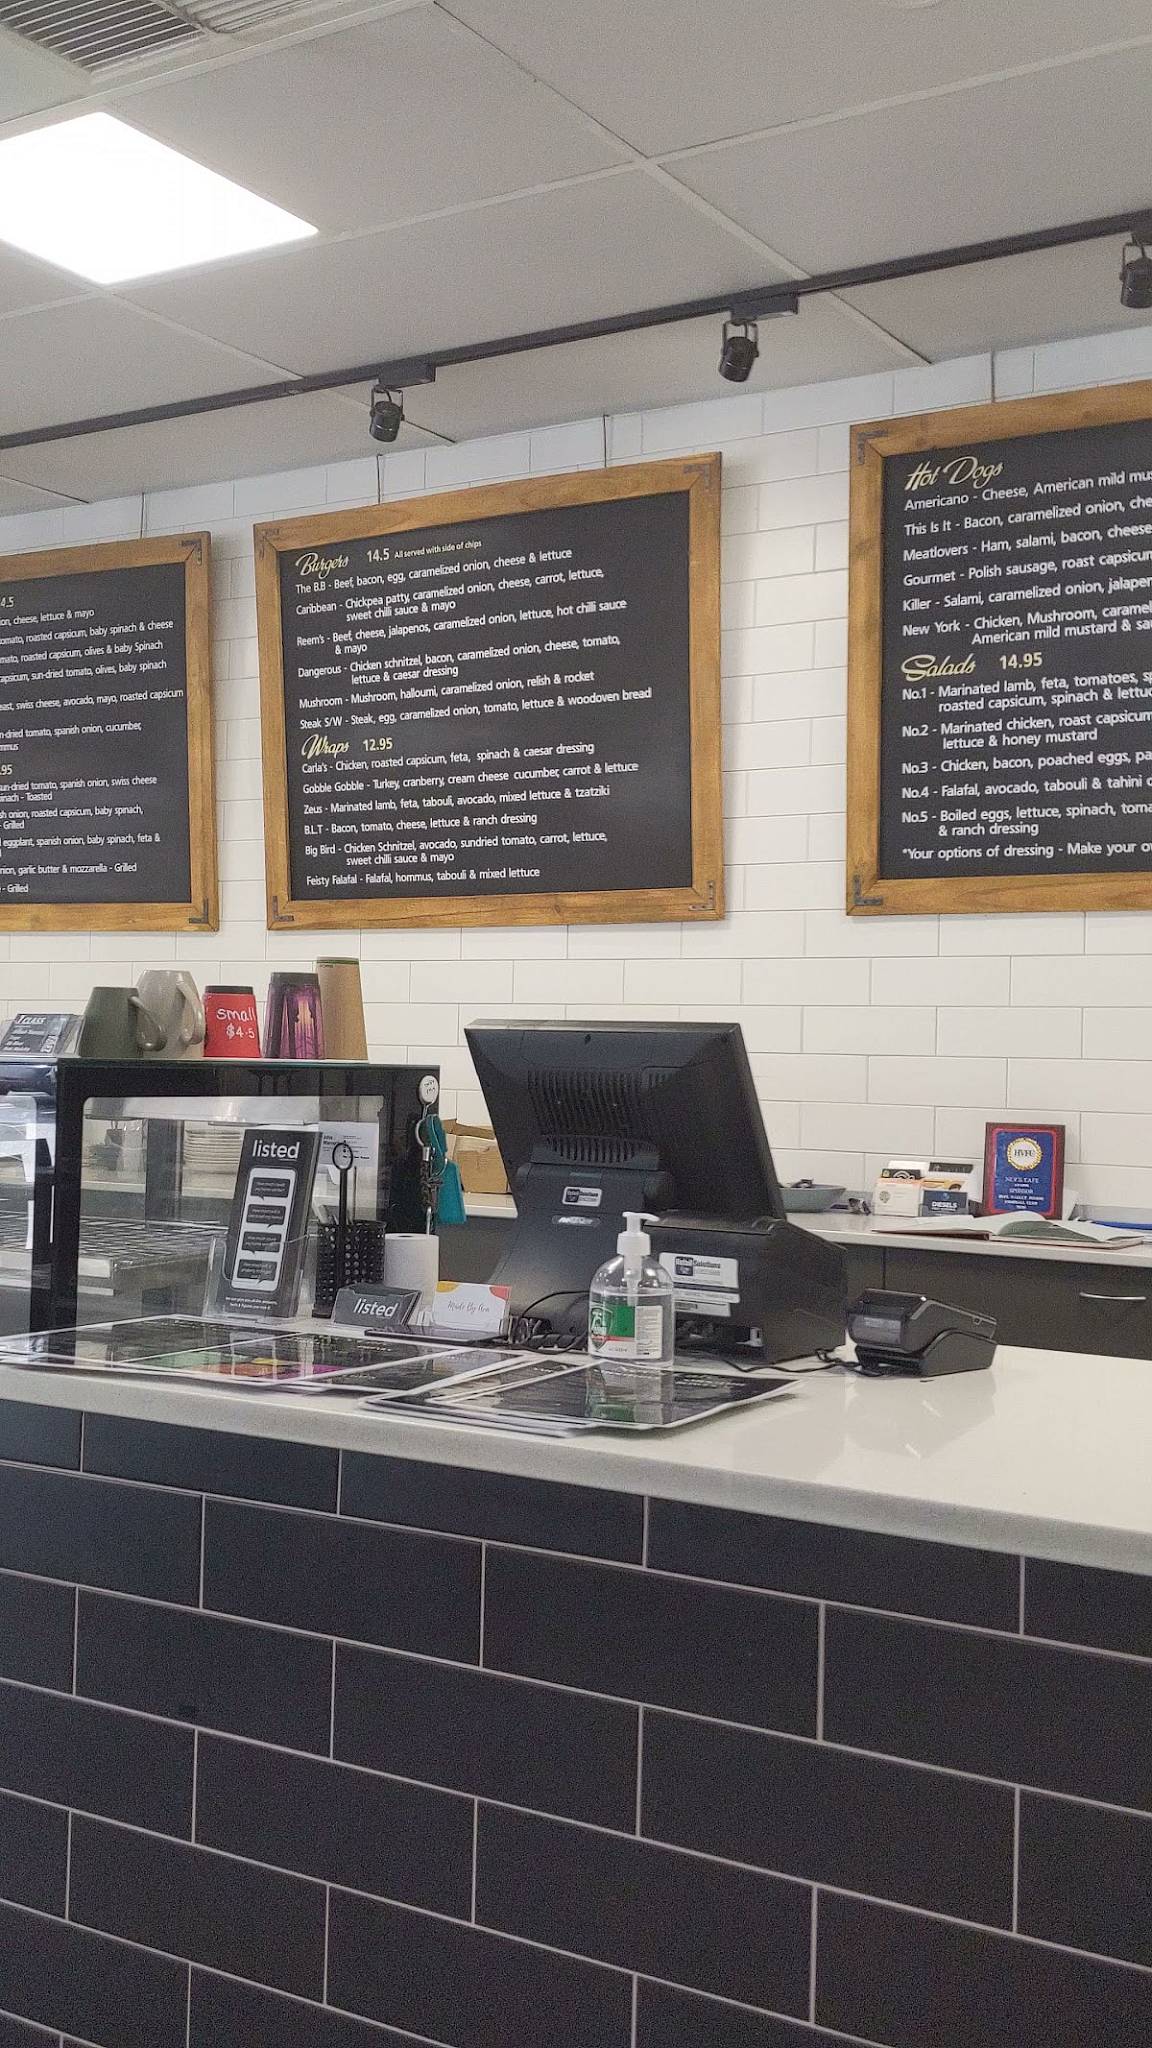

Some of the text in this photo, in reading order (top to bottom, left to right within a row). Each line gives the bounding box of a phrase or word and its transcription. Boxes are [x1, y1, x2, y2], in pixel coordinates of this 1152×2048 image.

[904, 456, 1003, 491] Hot Dogs
[904, 470, 1126, 511] Americano Cheese, American mild
[903, 499, 1126, 536] This Is It Bacon, caramelized onion,
[903, 529, 1103, 562] Meatlovers Ham, salami, bacon,
[295, 547, 390, 579] Burgers 14.5
[295, 583, 312, 594] The
[408, 562, 461, 579] caramelized
[493, 556, 526, 568] cheese
[539, 549, 573, 562] lettuce
[903, 554, 1095, 587] Gourmet Polish sausage, roast
[902, 580, 1105, 612] Killer Salami, caramelized onion,
[296, 634, 325, 647] Reem's
[433, 614, 486, 631] caramelized
[556, 605, 574, 616] hot
[575, 600, 597, 614] chilli
[598, 599, 628, 612] sauce
[902, 609, 1098, 637] New York Chicken, Mushroom,
[971, 619, 1117, 645] American mild mustard
[297, 665, 342, 679] Dangerous
[349, 660, 382, 672] Chicken
[457, 644, 510, 661] caramelized
[901, 651, 1043, 682] Salads 14.95
[902, 672, 1139, 701] No.1 Marinated lamb, feta, tomatoes,
[938, 688, 1099, 713] roasted capsicum, spinach
[299, 717, 322, 730] Steak
[324, 716, 343, 728] S/W
[399, 705, 451, 721] caramelized
[521, 698, 555, 710] lettuce
[567, 692, 620, 706] woodoven
[622, 686, 652, 701] bread
[902, 714, 1092, 737] No.2 Marinated chicken, roast
[942, 727, 1098, 750] lettuce honey mustard
[301, 733, 393, 760] Wraps 12.95
[901, 751, 1132, 775] No.3 Chicken, bacon, poached eggs,
[302, 782, 332, 794] Gobble
[334, 780, 365, 792] Gobble
[447, 774, 476, 785] cream
[477, 771, 510, 783] cheese
[562, 765, 592, 777] carrot
[604, 762, 639, 773] lettuce
[901, 775, 1143, 799] No.4 Falafal, avocado, tabouli tahini
[901, 802, 1117, 823] No.5 Boiled eggs, lettuce, spinach,
[951, 822, 1039, 837] ranch dressing
[305, 844, 318, 858] Big
[319, 843, 336, 855] Bird
[343, 842, 376, 854] Chicken
[460, 835, 499, 848] sundried
[937, 841, 1137, 862] options of dressing Make your
[251, 1139, 300, 1159] listed
[353, 1298, 399, 1318] listed
